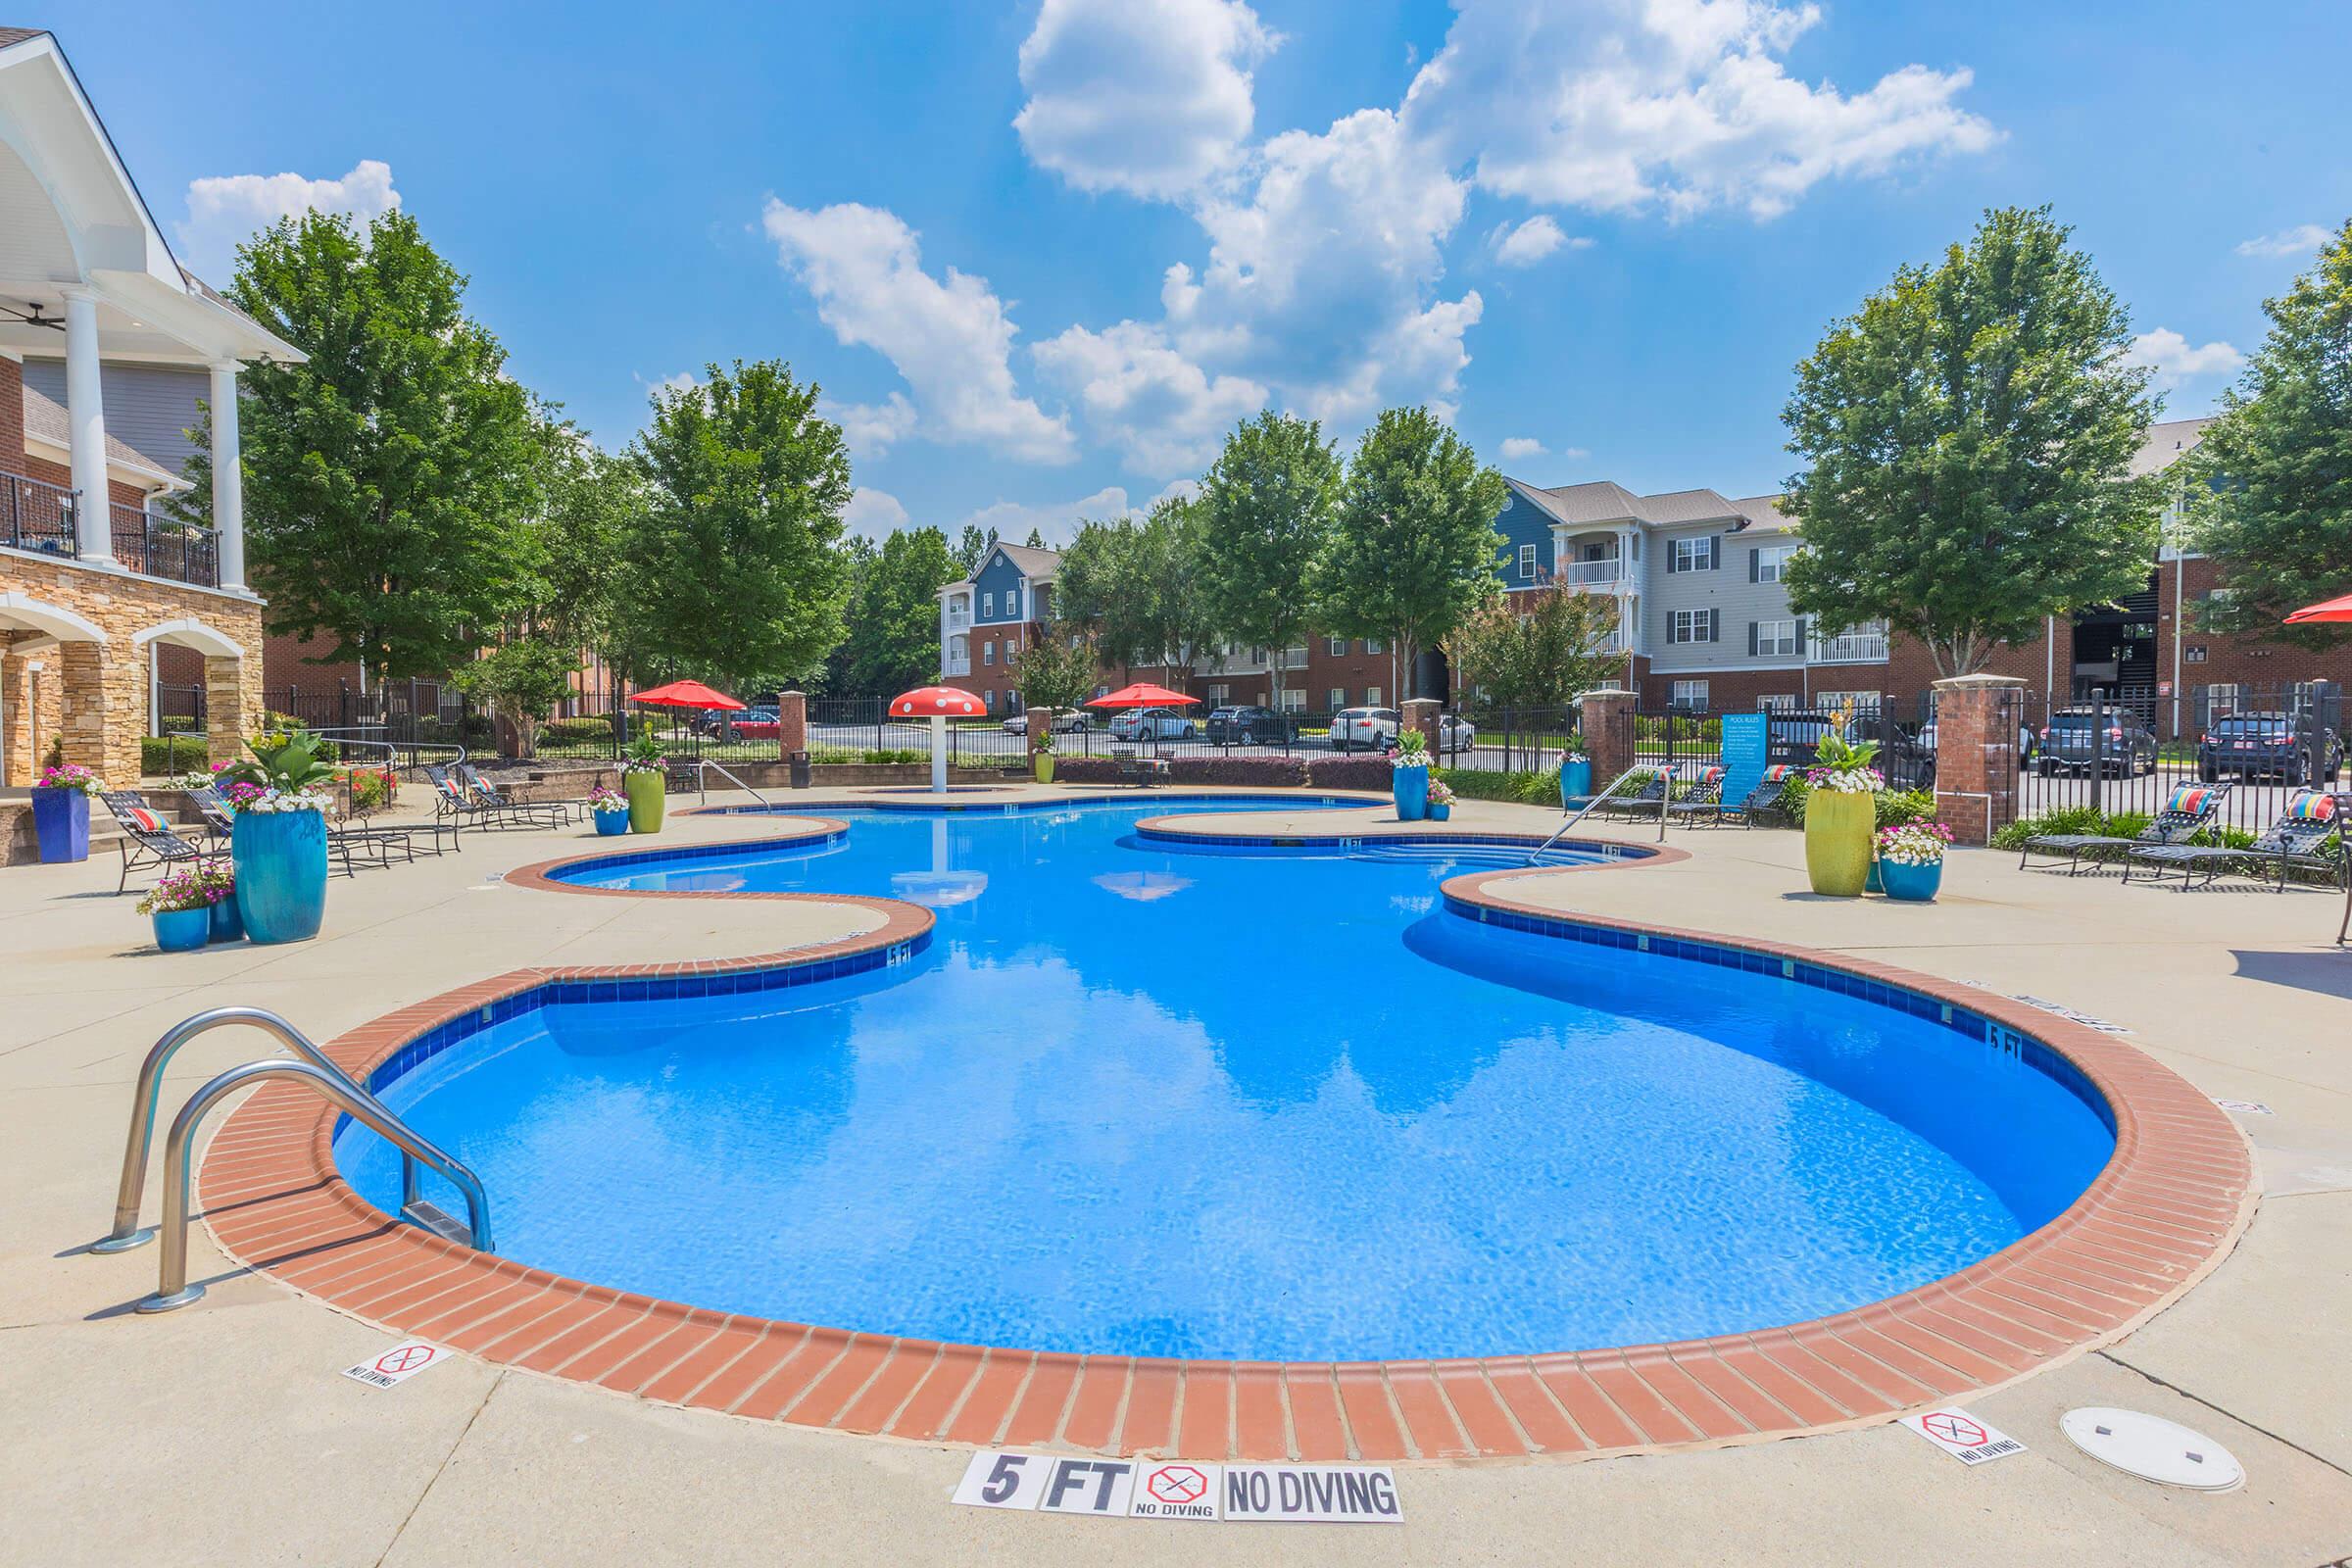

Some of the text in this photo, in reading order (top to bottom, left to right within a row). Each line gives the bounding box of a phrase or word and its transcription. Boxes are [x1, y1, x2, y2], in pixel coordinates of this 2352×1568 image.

[890, 944, 910, 965] 5 FT
[1990, 1026, 2021, 1058] 5 FT
[346, 1366, 397, 1387] NO DIVING
[1958, 1440, 2022, 1462] NO DIVING
[981, 1454, 1131, 1511] 5 FT
[1227, 1471, 1398, 1515] NO DIVING
[1135, 1503, 1213, 1517] NO DIVING
